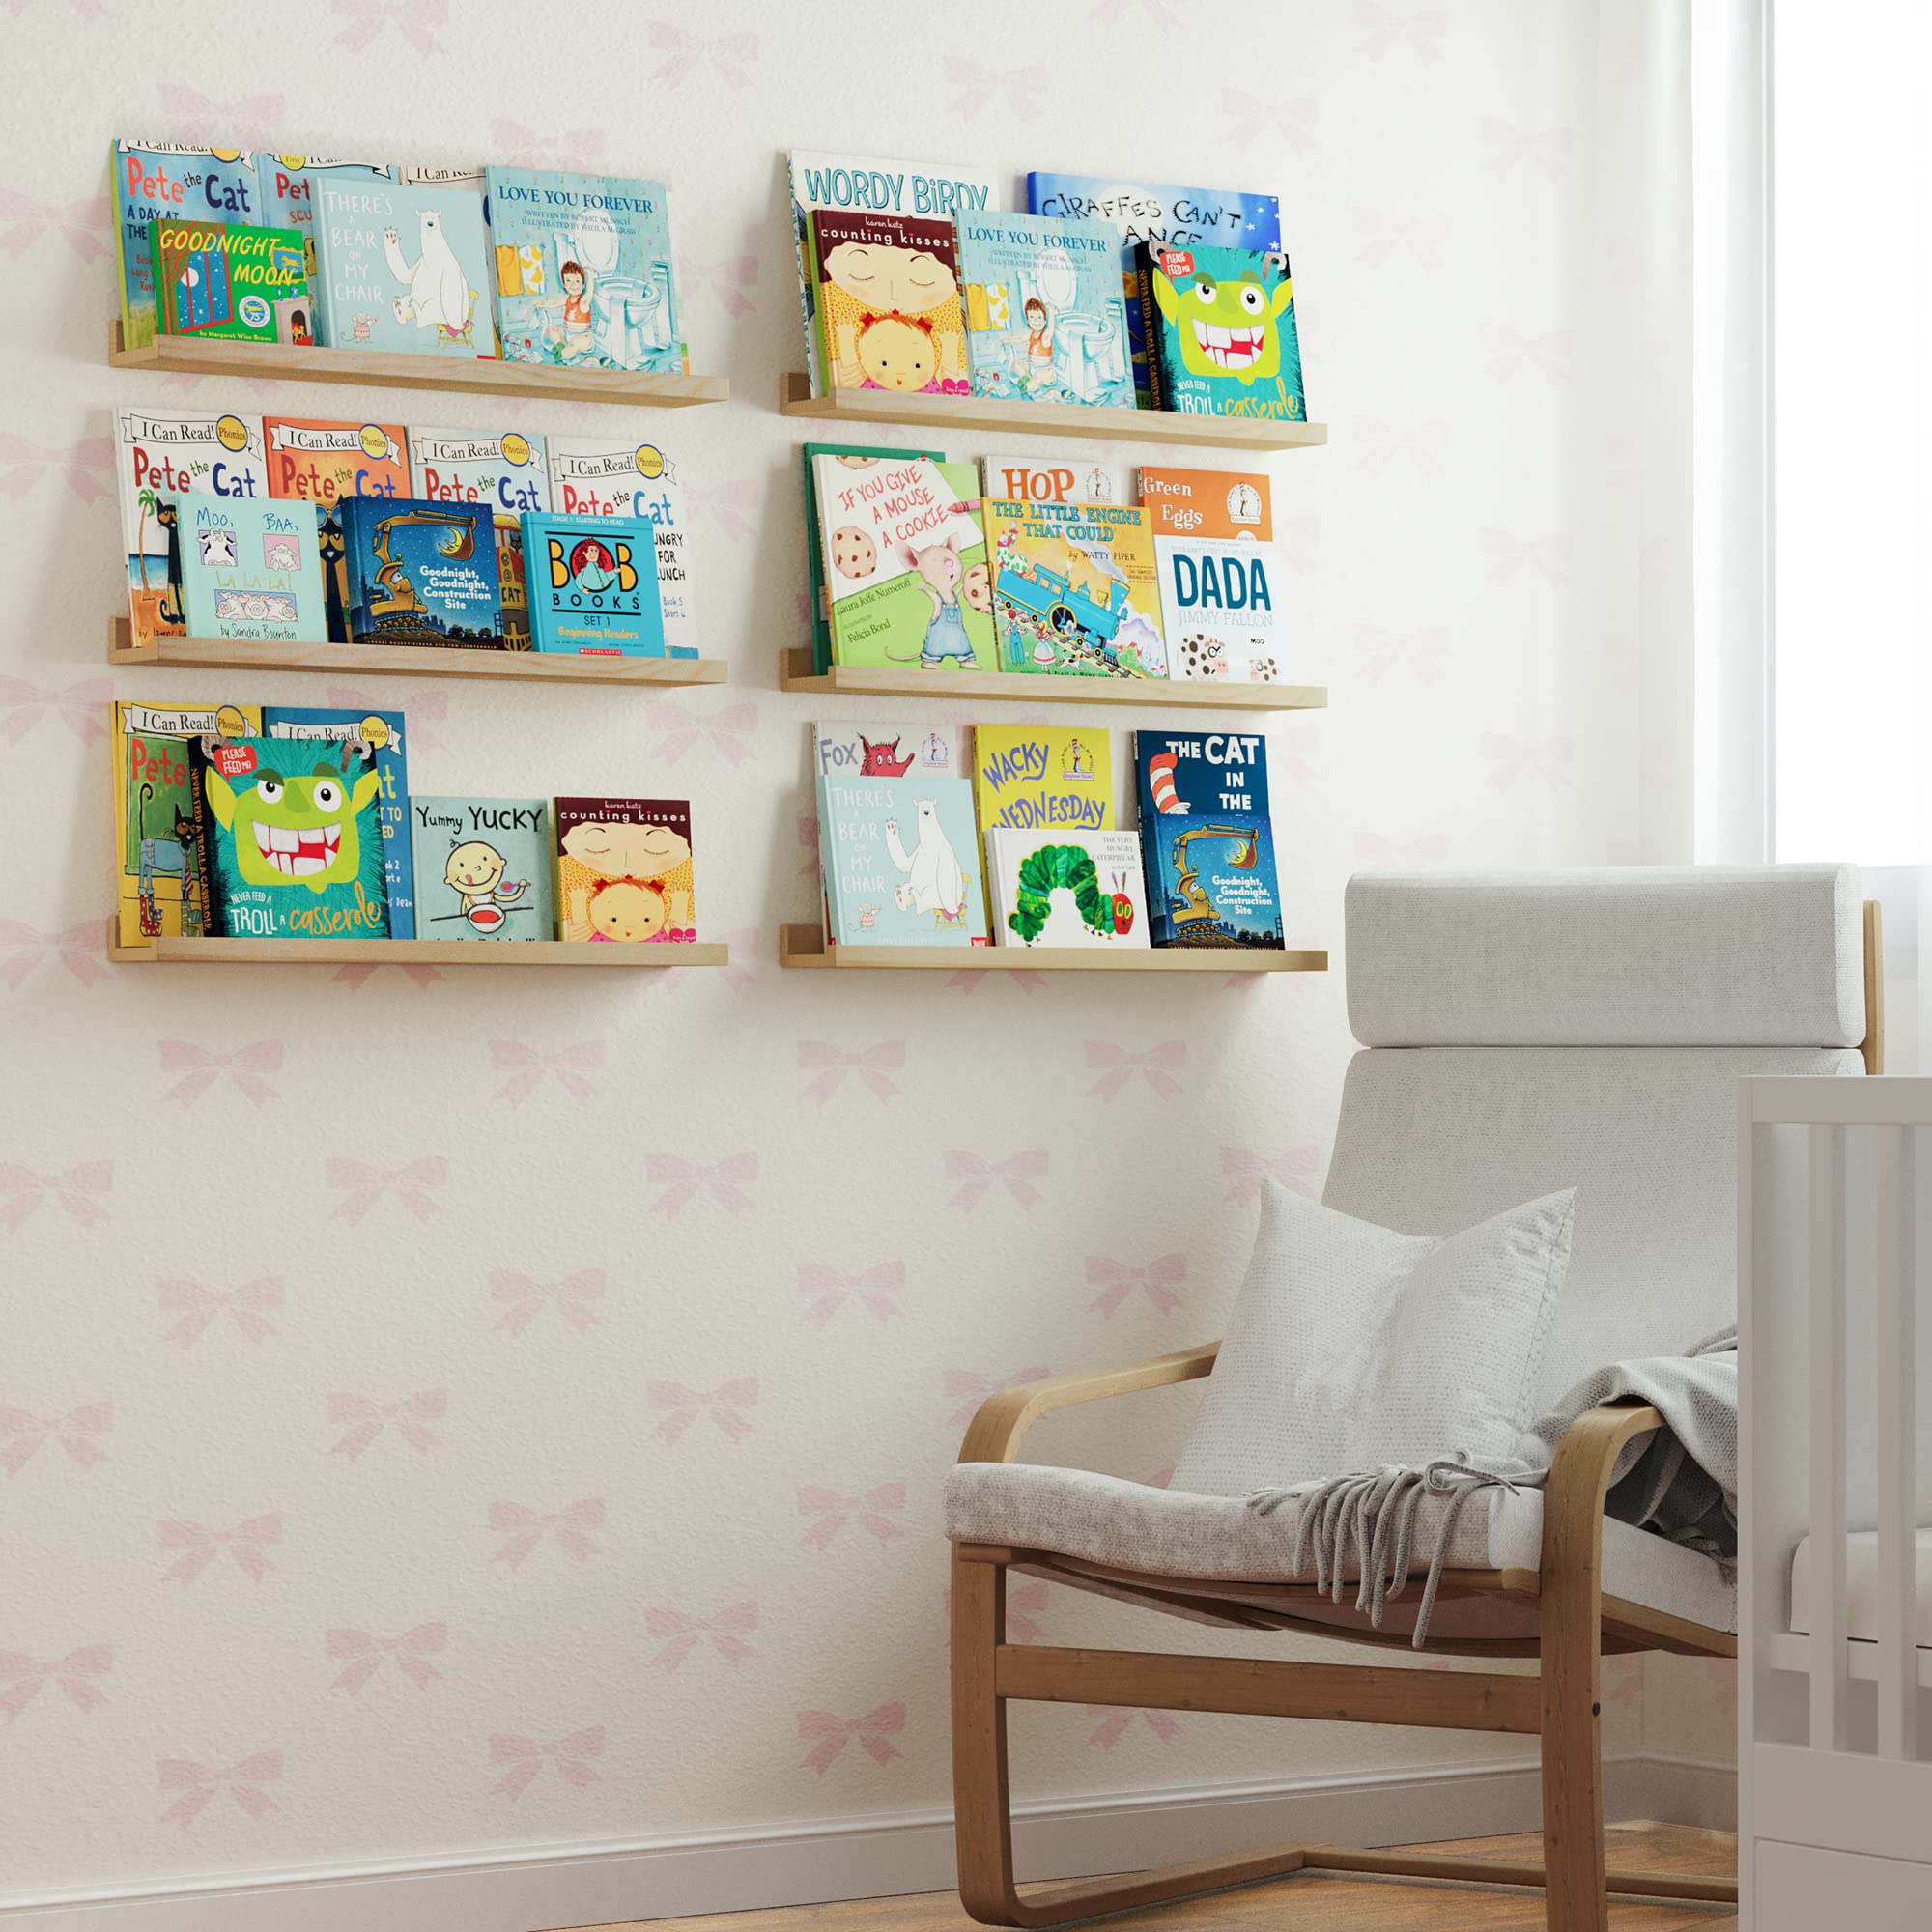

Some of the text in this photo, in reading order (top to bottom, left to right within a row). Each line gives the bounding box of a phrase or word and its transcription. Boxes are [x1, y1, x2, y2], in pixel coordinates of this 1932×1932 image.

[128, 156, 250, 212] Pete the Cat
[804, 168, 903, 211] WORDY
[325, 191, 394, 215] THERE'S
[498, 185, 653, 213] LOVE YOU FOREVER
[128, 205, 160, 220] A DAY
[526, 210, 558, 219] WRITTEN
[1042, 193, 1241, 229] GIRAFFES CAN'T
[128, 223, 147, 240] THE
[522, 218, 569, 229] ILLUSTRATED
[160, 229, 280, 258] GOODNIGHT
[332, 227, 378, 249] BEAR
[821, 228, 950, 248] counting kisses
[967, 227, 1107, 252] LOVE YOU FOREVER
[349, 251, 361, 260] ON
[1166, 251, 1186, 264] PLEASE
[234, 264, 296, 286] MOON
[345, 264, 368, 280] MY
[1167, 264, 1183, 276] FEED
[335, 283, 384, 304] CHAIR
[1140, 298, 1154, 356] FEED TROLL
[1225, 376, 1298, 420] casserole
[143, 422, 215, 440] I Can Read!
[218, 427, 246, 440] Phonics
[290, 431, 357, 448] I Can Read!
[361, 435, 387, 448] Phonics
[433, 442, 500, 460] I Can Read!
[570, 456, 635, 475] I Can Read!
[637, 457, 662, 468] Phonics
[133, 446, 257, 498] Pete the Cat
[281, 454, 396, 498] Pete the Cat
[425, 467, 541, 512] Pete the Cat
[838, 465, 923, 511] IF YOU GIVE
[1001, 469, 1075, 502] HOP
[1144, 476, 1192, 497] Green
[563, 484, 674, 526] Pete the Cat
[872, 486, 935, 525] A MOUSE
[992, 501, 1142, 526] THE LITTLE ENGINE
[1161, 504, 1203, 530] Eggs
[882, 504, 949, 549] A COOKIE
[1023, 523, 1114, 542] THAT COULD
[548, 538, 639, 592] BOB
[658, 550, 676, 563] FOR
[1068, 551, 1136, 562] by WATTY PIPER
[216, 571, 261, 588] LA LA
[420, 565, 479, 580] Goodnight,
[429, 577, 489, 591] Goodnight,
[1172, 554, 1271, 611] DADA
[423, 586, 492, 600] Construction
[501, 586, 521, 603] CAT
[553, 593, 639, 609] BOOKS
[663, 596, 676, 606] Book
[837, 579, 912, 616] Laura Numeroff
[445, 598, 467, 610] Site
[584, 615, 611, 626] SET 1
[664, 609, 679, 618] Short
[1179, 611, 1273, 627] JIMMY FALLON
[220, 623, 297, 641] by Sandra Boynton
[557, 625, 639, 641] Beginning Readers
[846, 627, 871, 644] Felicia
[870, 618, 892, 636] Bond
[143, 712, 213, 730] I Can Read!
[217, 718, 243, 732] Phonics
[325, 726, 357, 741] Read!
[361, 727, 387, 738] Phonics
[221, 747, 246, 760] PLEASE
[1166, 735, 1259, 765] THE CAT
[131, 738, 186, 786] Pete
[223, 760, 242, 774] FEED
[982, 742, 1049, 794] WACKY
[1225, 772, 1245, 787] IN
[605, 800, 625, 809] karen
[832, 785, 895, 808] THERE'S
[1219, 793, 1252, 810] THE
[415, 806, 463, 835] Yummy
[560, 810, 686, 823] counting kisses
[838, 822, 880, 841] BEAR
[190, 768, 212, 930] NEVER FEED TROLL CASSEROLE
[854, 843, 866, 852] ON
[851, 856, 872, 871] MY
[842, 876, 887, 895] CHAIR
[1212, 875, 1263, 888] Goodnight,
[230, 891, 272, 905] NEVER FEED A
[1216, 895, 1273, 905] Construction
[1221, 886, 1270, 897] Goodnight,
[230, 881, 381, 935] TROLL A casserole
[396, 897, 412, 907] Dean
[1234, 905, 1252, 915] Site
